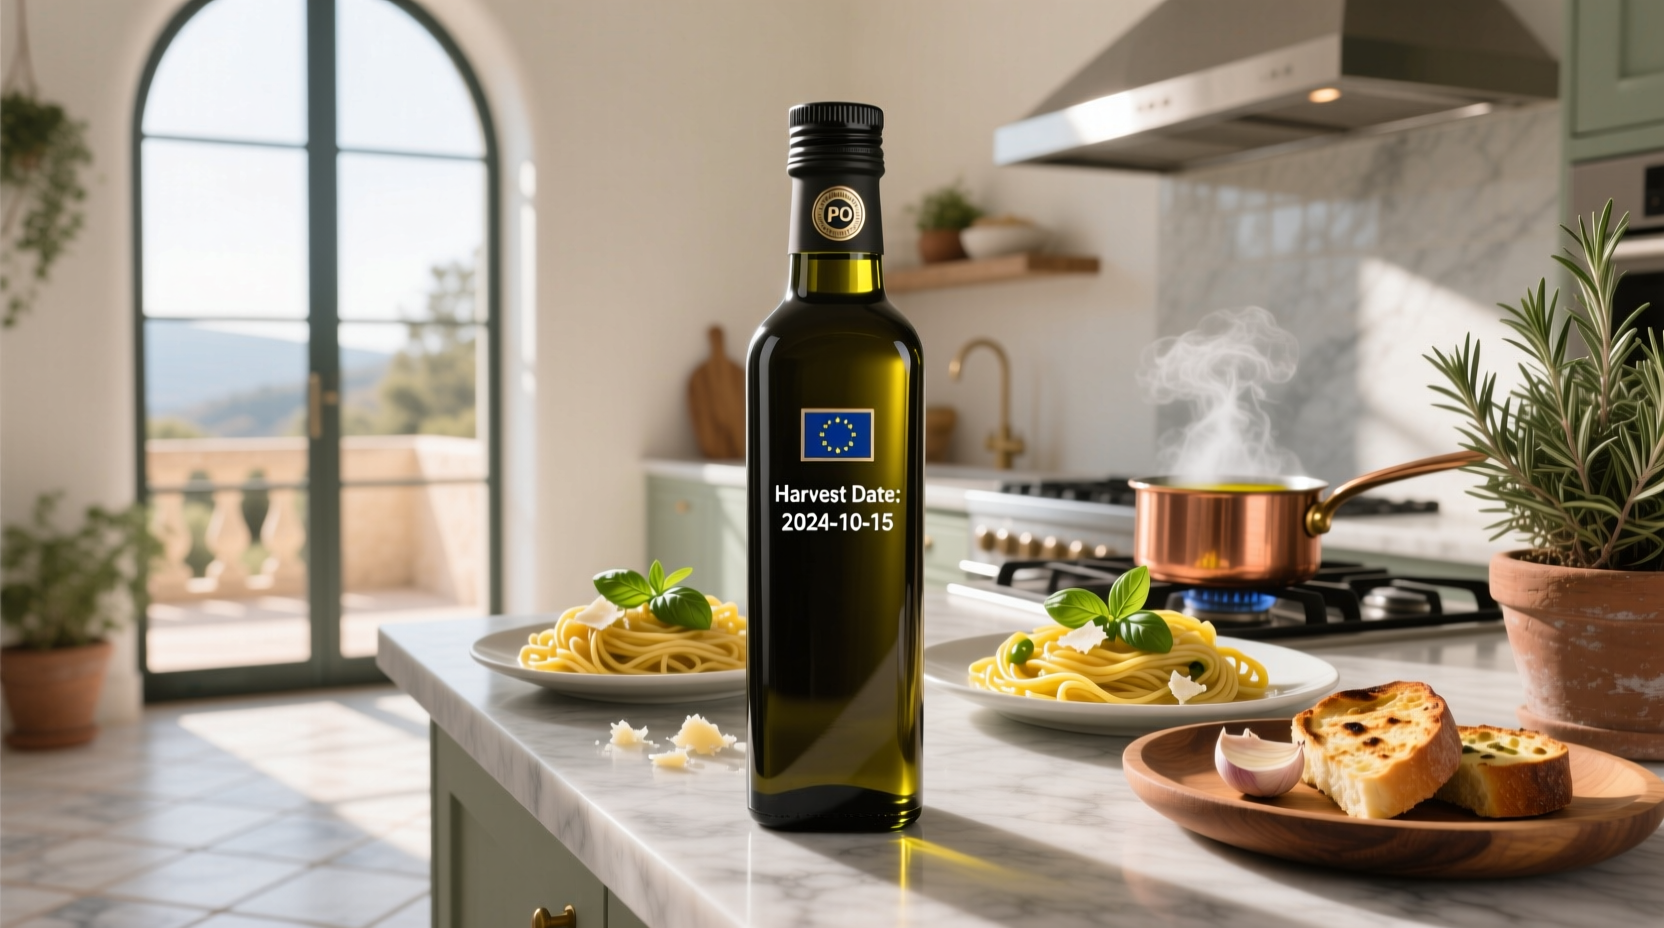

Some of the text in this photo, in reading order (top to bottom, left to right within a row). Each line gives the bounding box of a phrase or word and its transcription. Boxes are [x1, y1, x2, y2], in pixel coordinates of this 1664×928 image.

[827, 206, 853, 223] PO
[775, 484, 901, 504] Harvest Date:
[781, 512, 894, 532] 2024-10-15
